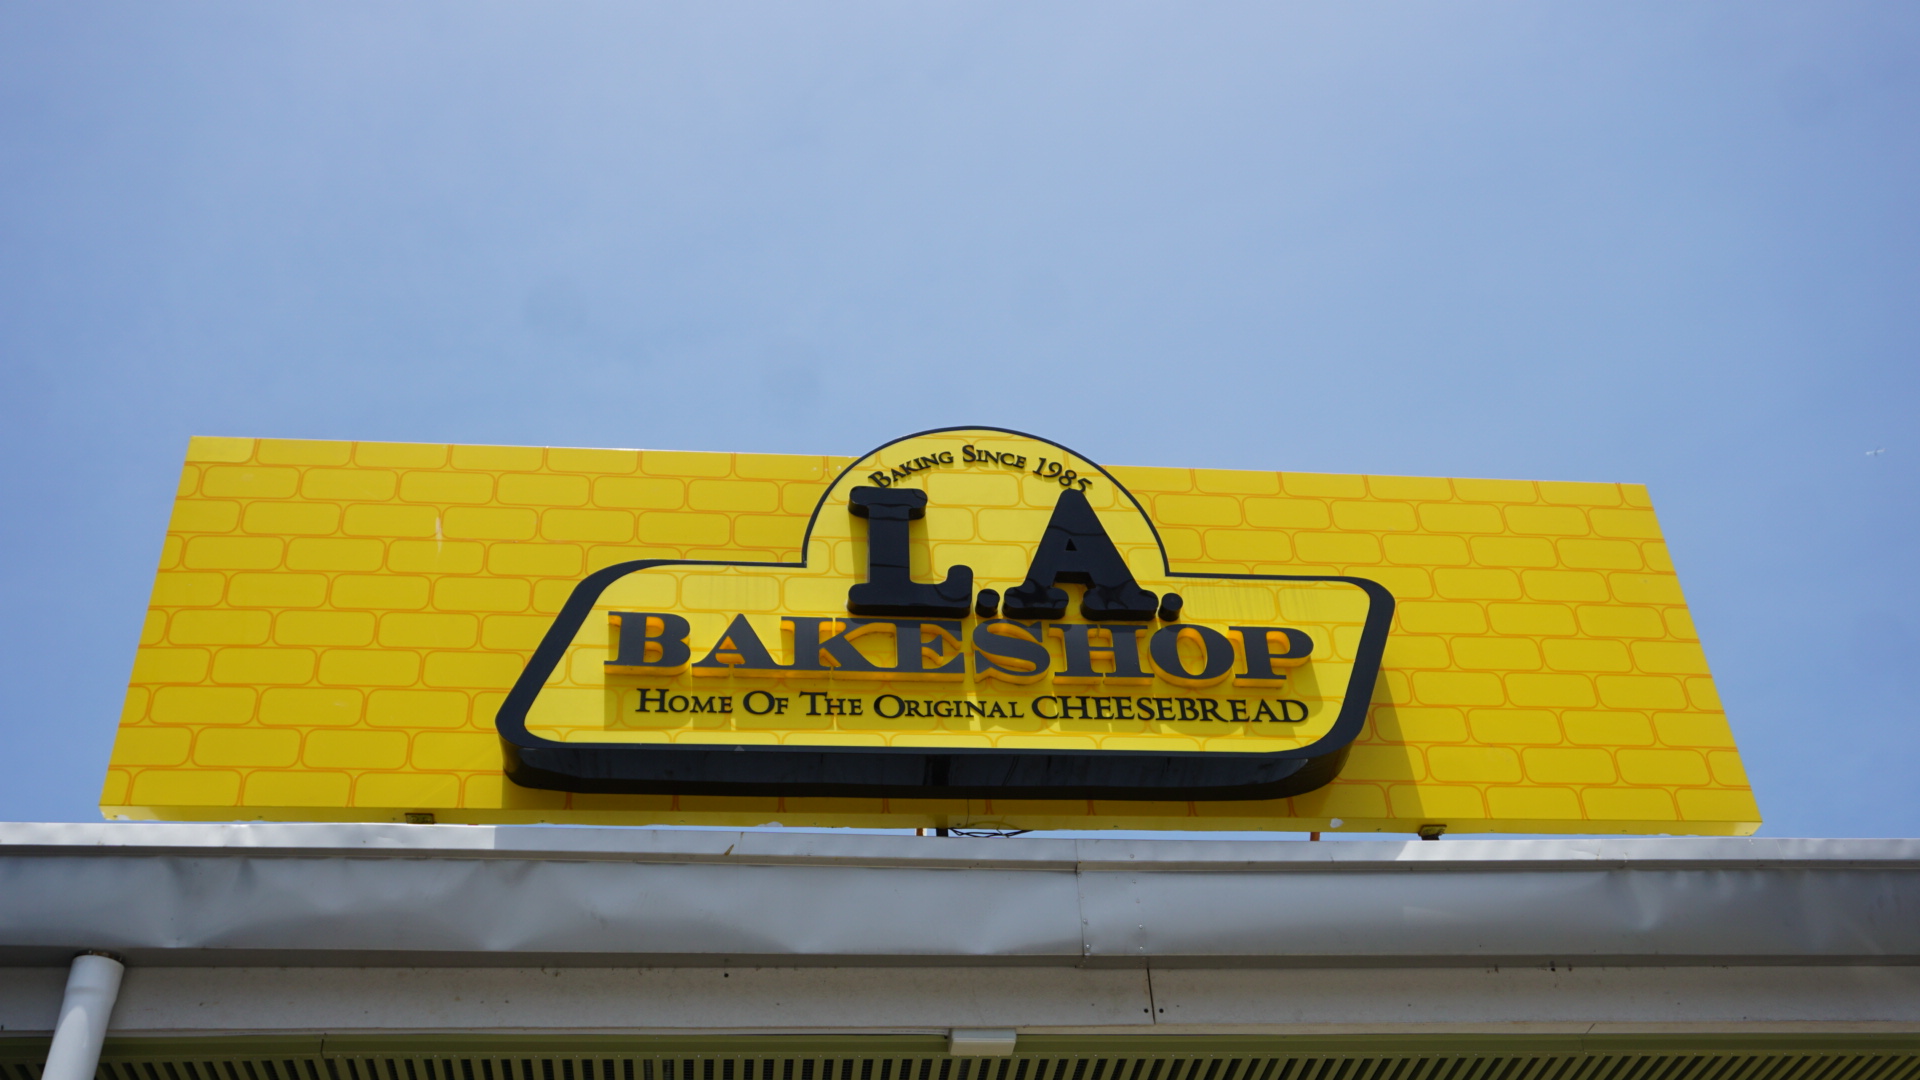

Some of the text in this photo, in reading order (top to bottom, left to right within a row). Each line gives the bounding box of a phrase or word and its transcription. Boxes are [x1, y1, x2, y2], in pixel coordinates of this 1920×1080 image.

[962, 445, 1026, 471] SINCE
[1032, 456, 1093, 493] 1985
[847, 485, 1183, 622] L.A.
[603, 610, 1315, 687] BAKESHOP
[635, 688, 1309, 723] HOME OF THE ORIGINAL CHEESEBREAD
